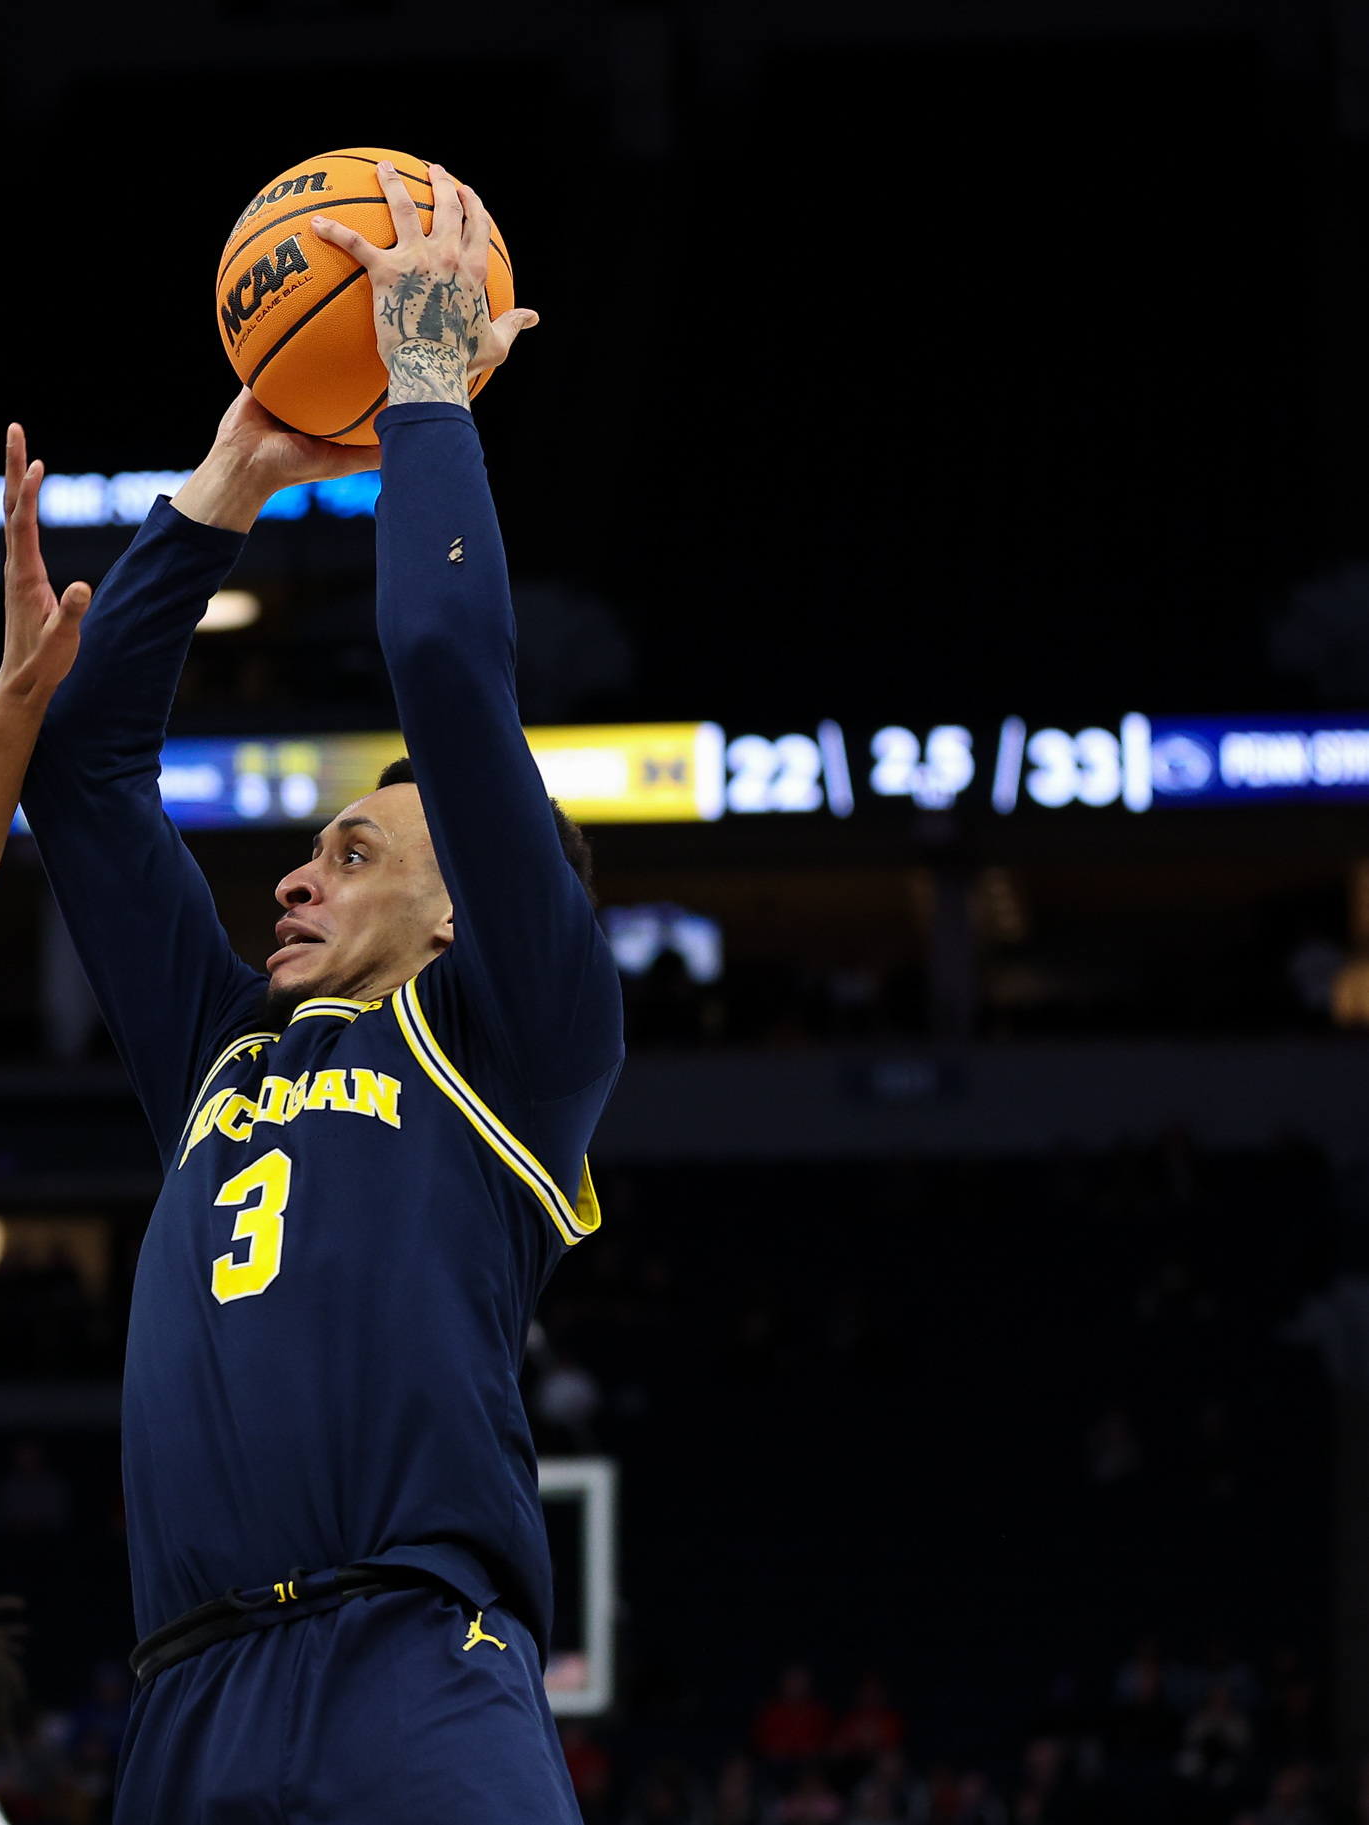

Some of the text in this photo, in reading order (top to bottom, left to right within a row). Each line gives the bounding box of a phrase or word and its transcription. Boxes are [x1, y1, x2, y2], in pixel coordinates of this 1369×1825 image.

[221, 235, 311, 348] NCAA
[256, 296, 282, 323] GAME
[282, 276, 314, 298] BALL
[727, 733, 823, 813] 22
[1026, 727, 1123, 808] 33
[212, 1148, 292, 1304] 3
